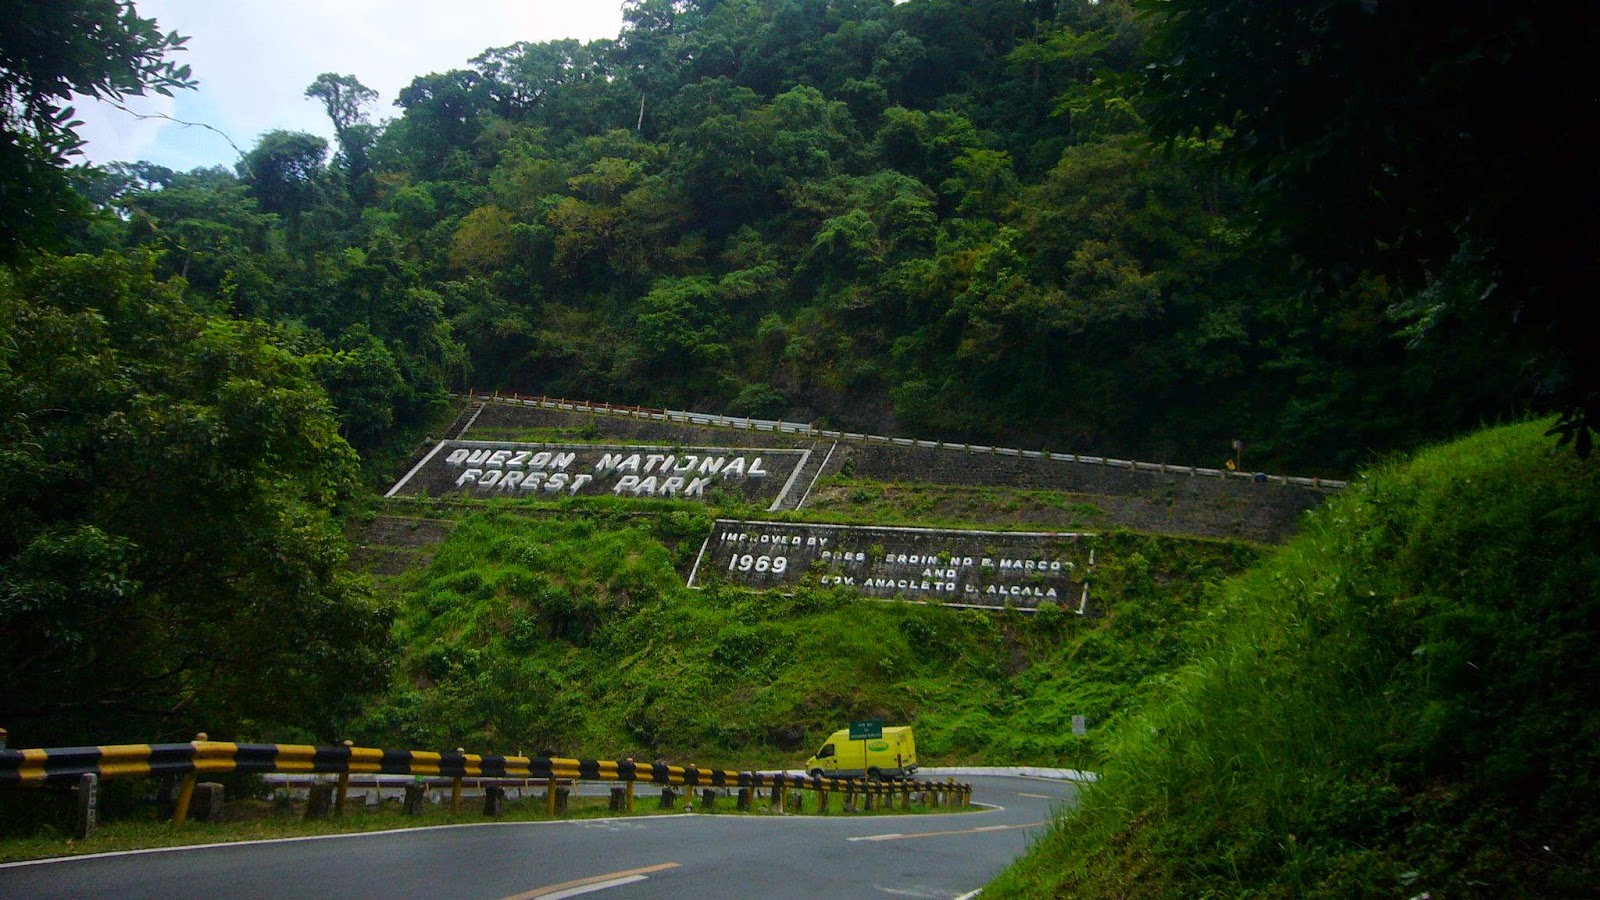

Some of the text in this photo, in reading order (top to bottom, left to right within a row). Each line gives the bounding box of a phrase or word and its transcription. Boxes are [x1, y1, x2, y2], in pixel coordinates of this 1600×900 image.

[446, 449, 767, 480] QUEZON NATIONAL
[455, 468, 712, 499] FOREST PARK
[807, 537, 829, 547] BY
[728, 553, 788, 575] 1969
[874, 552, 973, 567] ERDINND
[922, 568, 957, 579] AND
[864, 578, 956, 592] ANACLETO
[986, 584, 1057, 598] ALCALA
